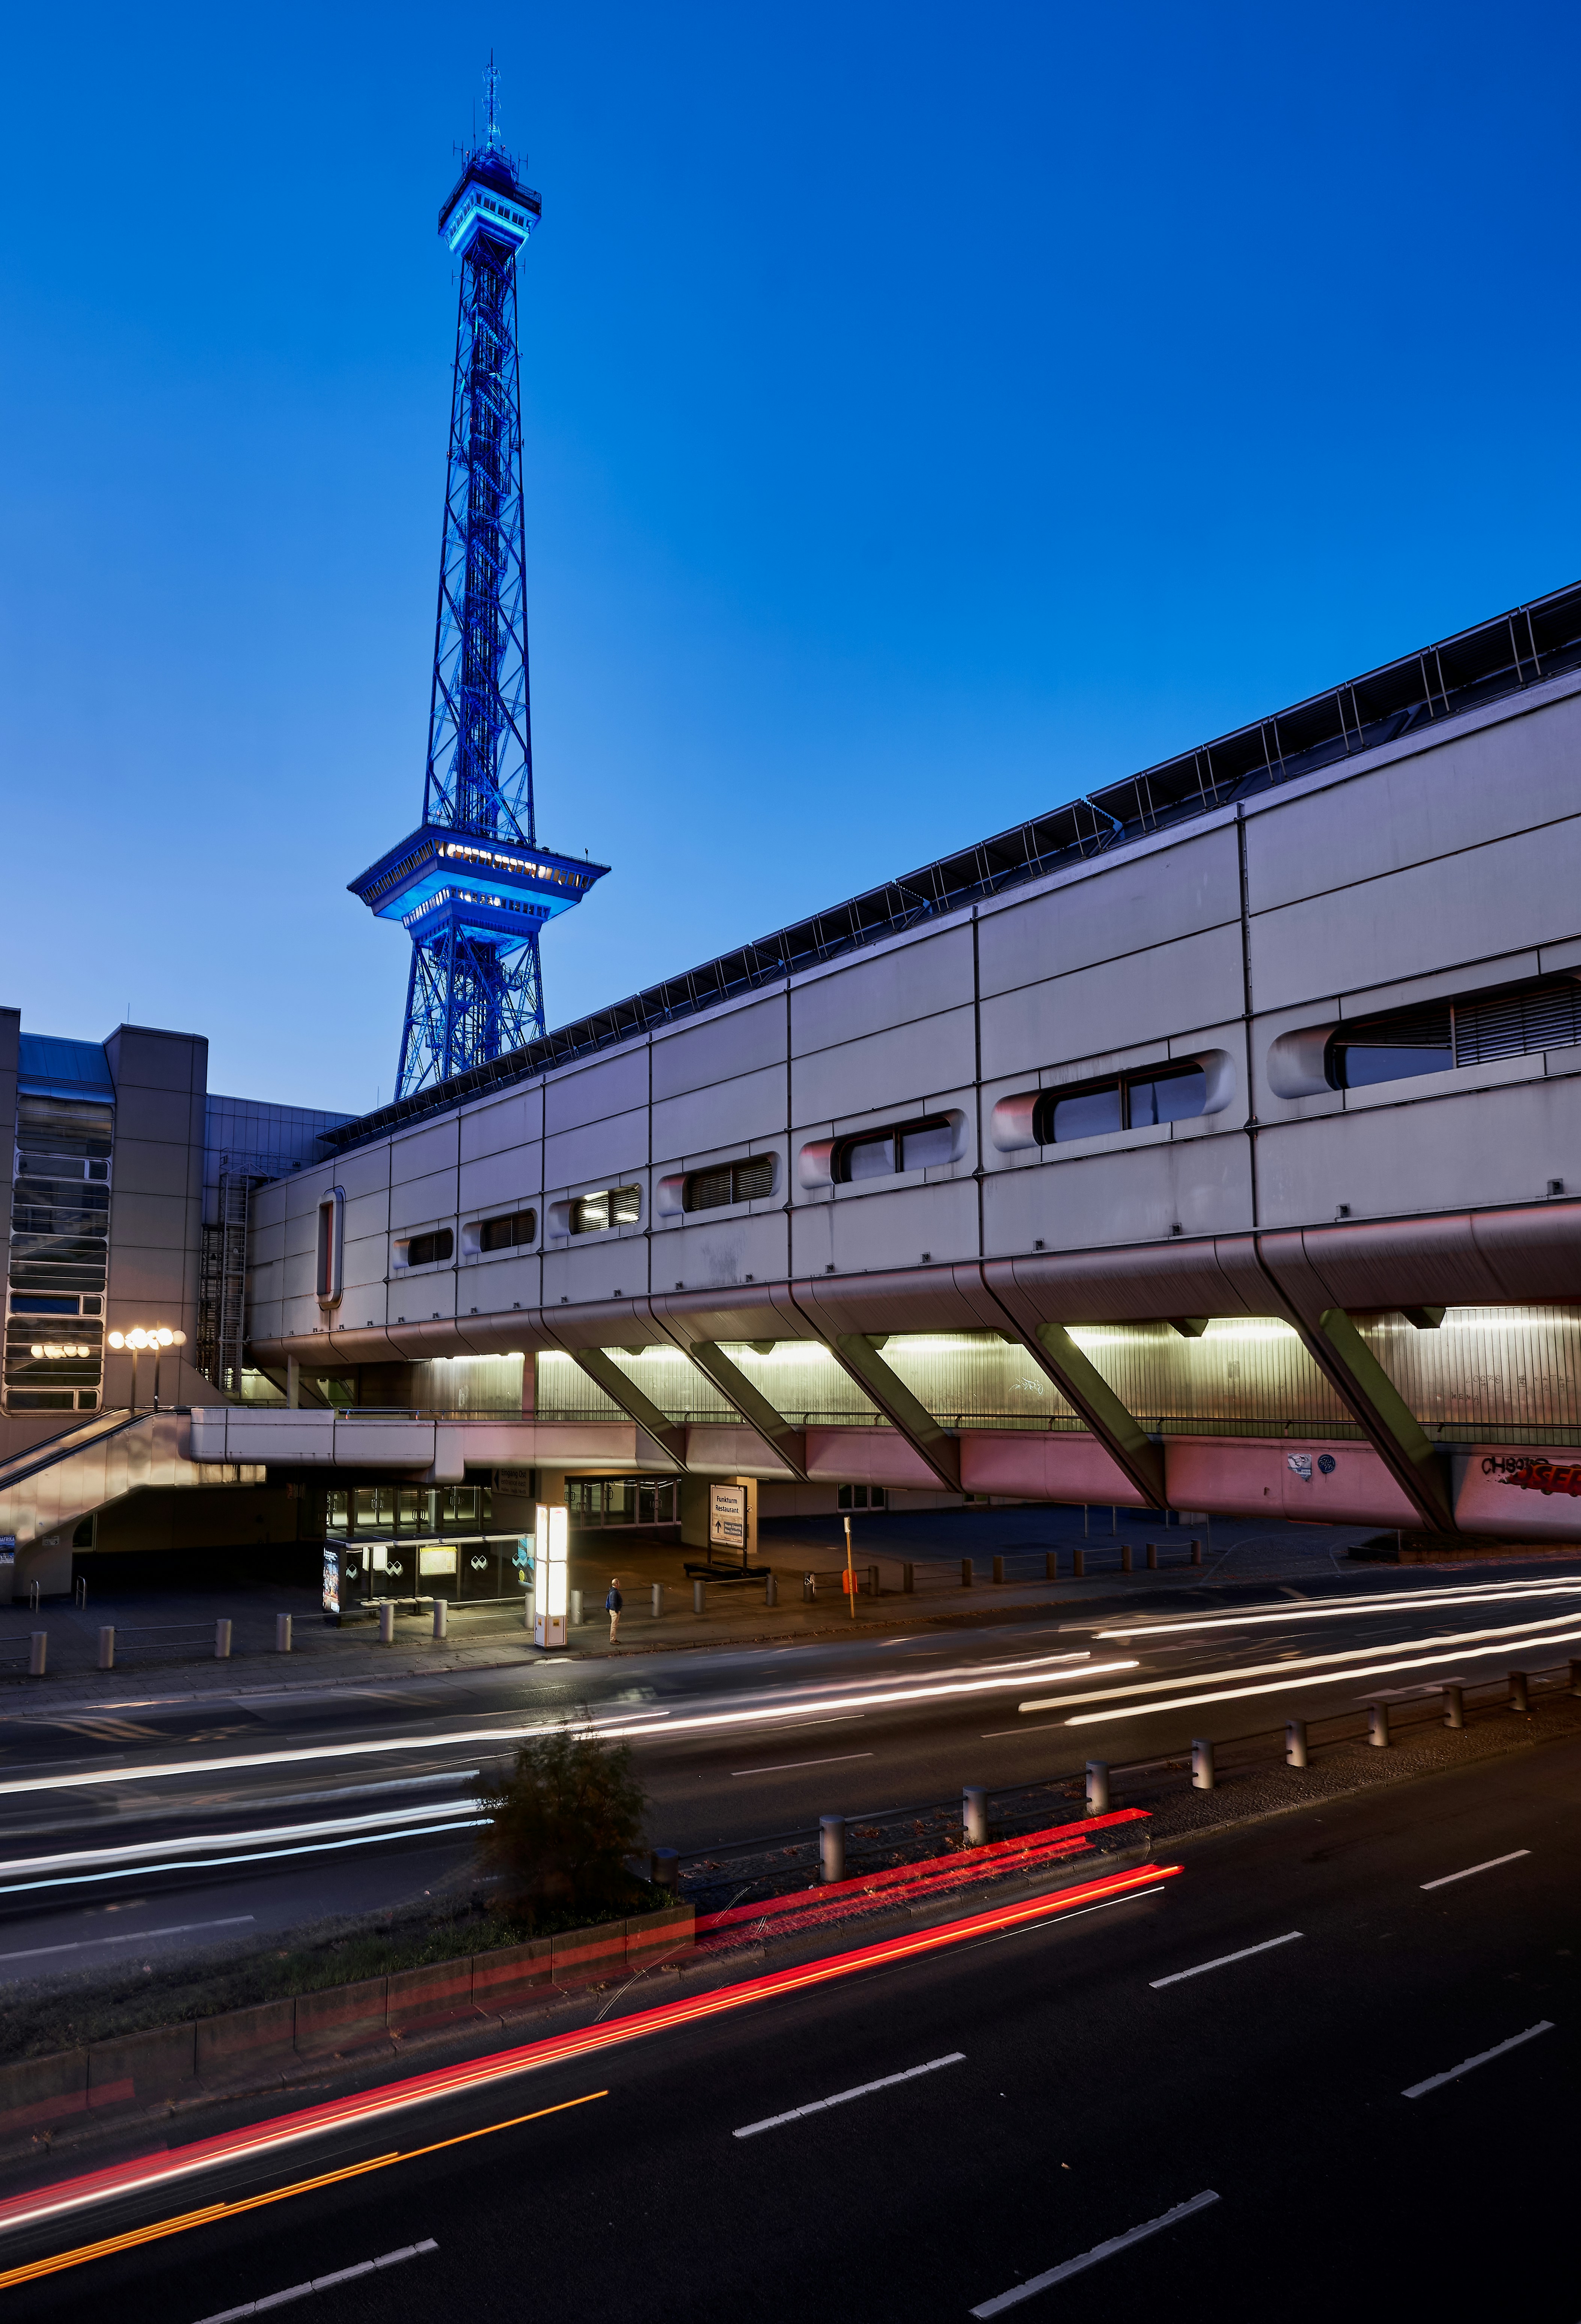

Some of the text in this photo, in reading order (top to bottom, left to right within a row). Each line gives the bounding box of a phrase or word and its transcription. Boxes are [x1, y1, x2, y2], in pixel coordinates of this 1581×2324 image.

[501, 1468, 518, 1478] Eingang
[717, 1495, 737, 1504] Funkturm
[716, 1504, 739, 1513] Restaurant
